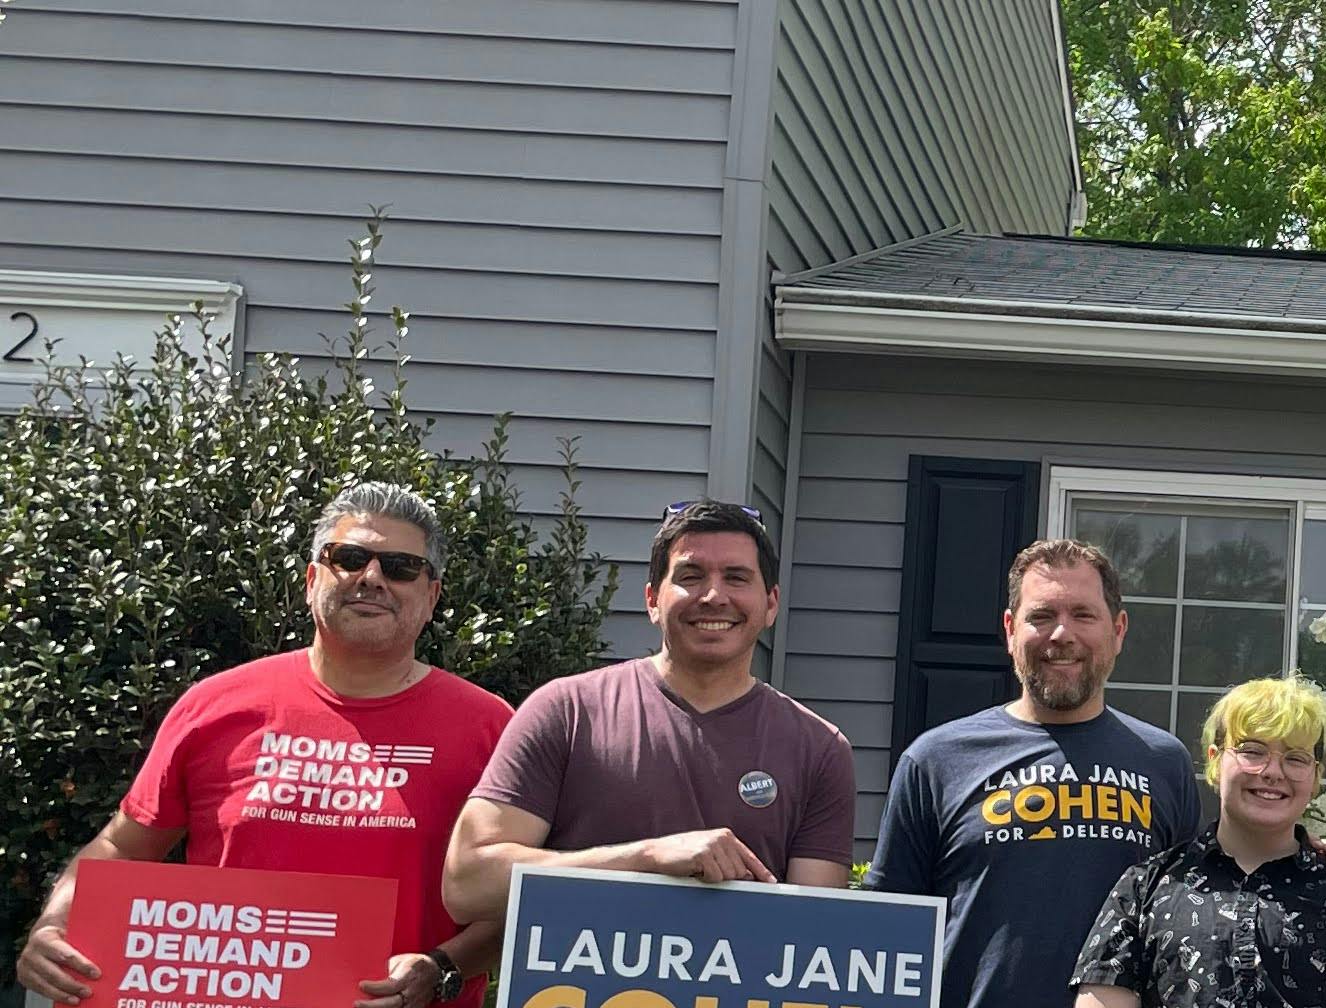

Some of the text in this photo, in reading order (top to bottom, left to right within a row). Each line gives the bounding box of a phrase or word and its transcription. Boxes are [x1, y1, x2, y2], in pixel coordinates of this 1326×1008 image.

[3, 311, 39, 363] 2
[260, 732, 372, 763] MOMS
[254, 756, 408, 788] DEMAND
[740, 778, 773, 792] ALBERT
[984, 763, 1150, 794] LAURA JANE
[246, 780, 384, 811] ACTION
[981, 785, 1152, 829] COHEN
[241, 806, 416, 829] FOR GUN SENSE IN AMERICA
[984, 825, 1151, 848] FOR DELEGATE
[129, 898, 263, 933] MOMS
[124, 932, 311, 969] DEMAND
[525, 925, 924, 997] LAURA JANE
[118, 964, 282, 1000] ACTION
